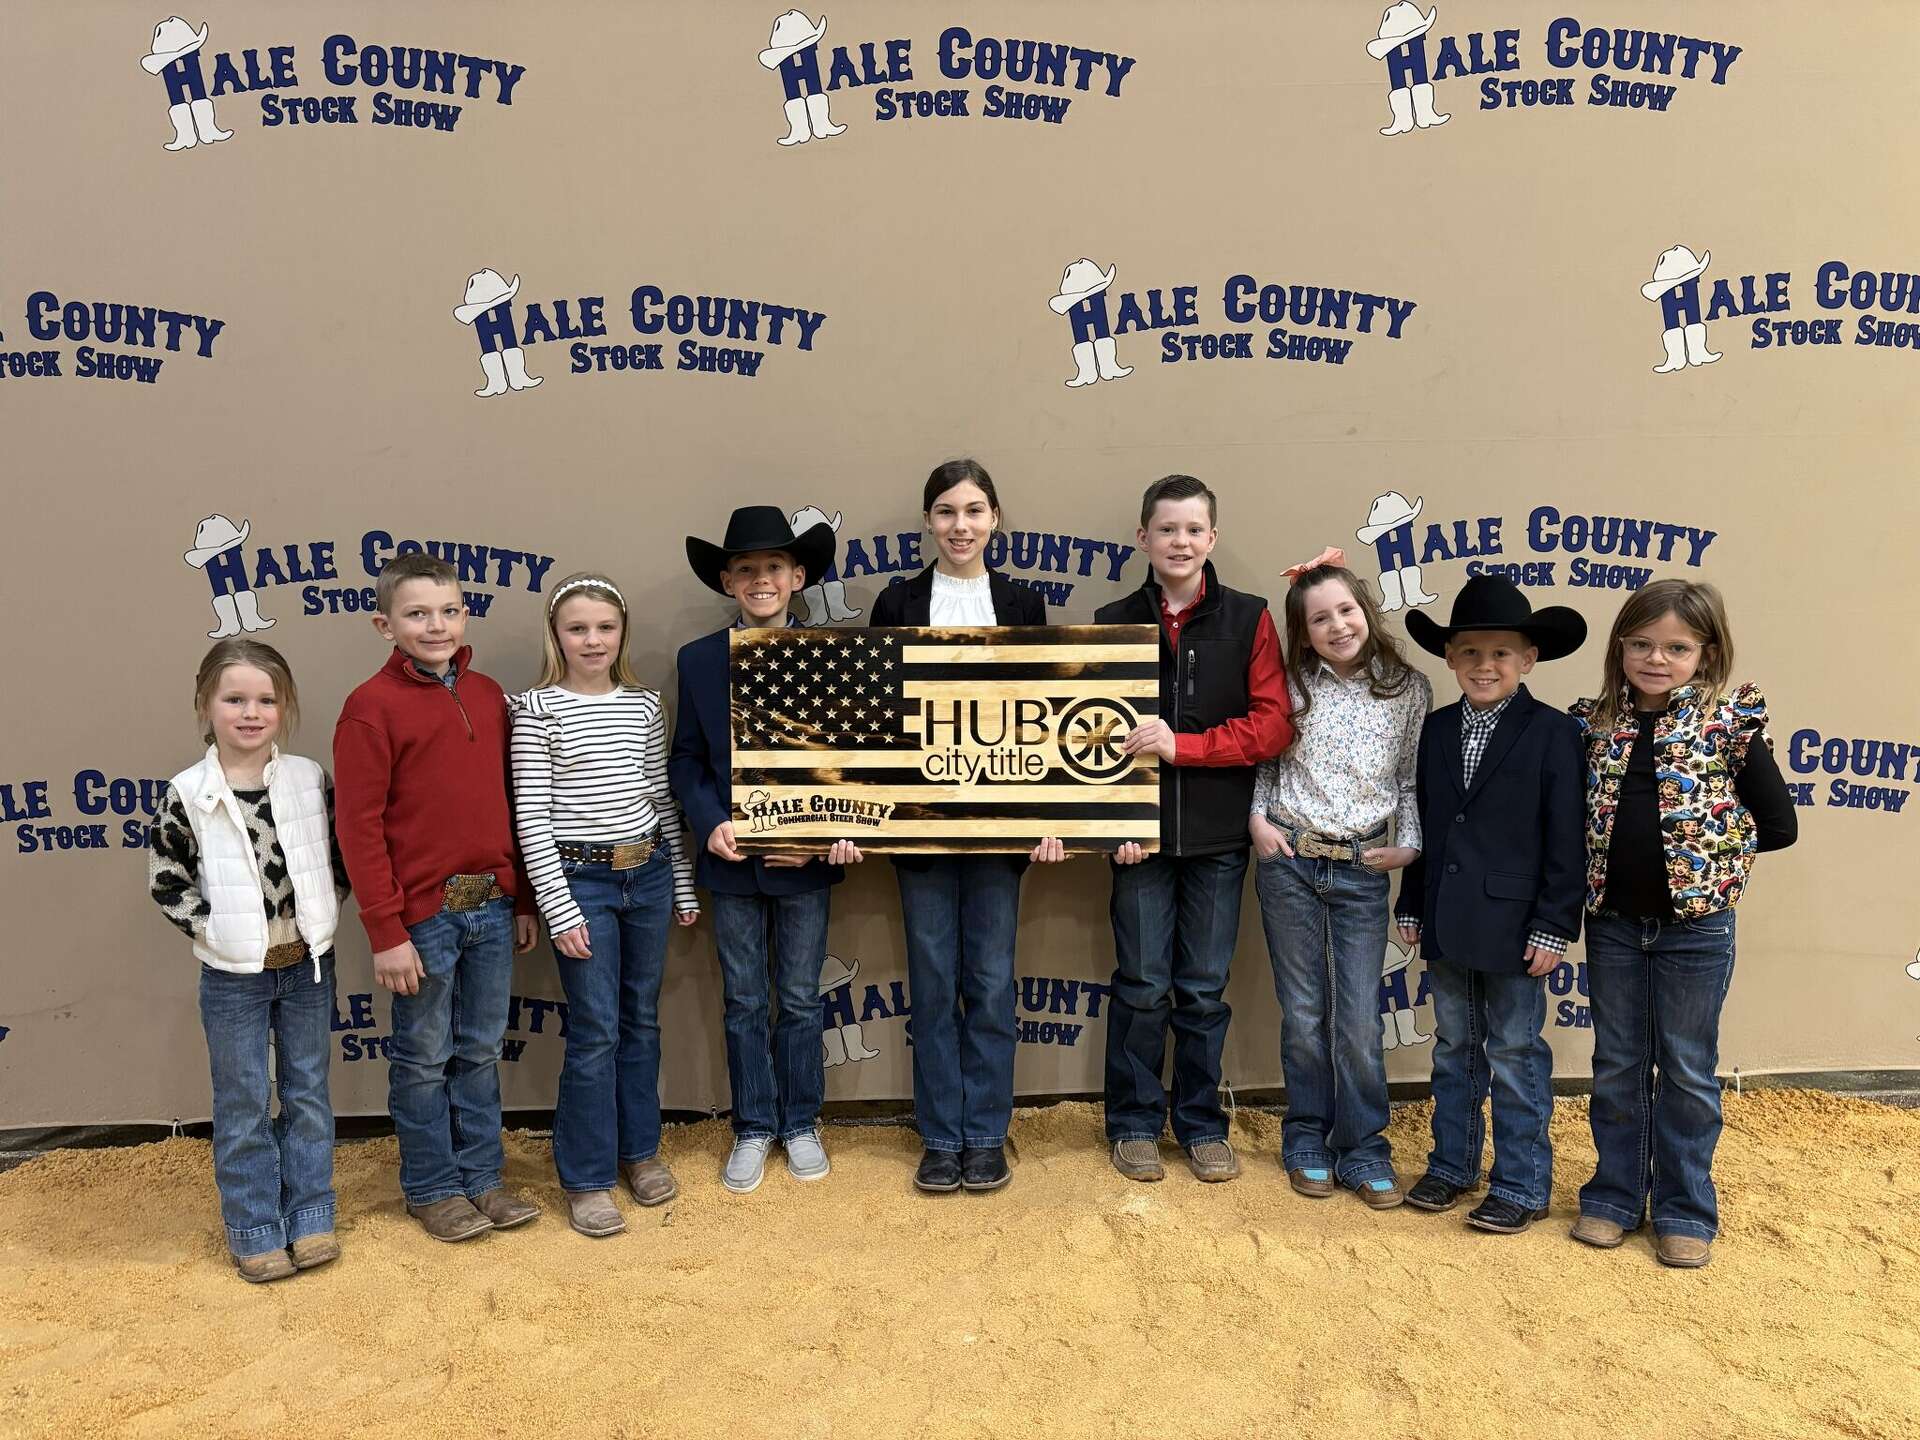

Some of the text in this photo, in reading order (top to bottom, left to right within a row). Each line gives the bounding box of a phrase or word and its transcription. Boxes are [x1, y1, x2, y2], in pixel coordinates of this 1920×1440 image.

[937, 26, 1137, 98] COUNTY
[1544, 17, 1744, 85] COUNTY
[320, 34, 527, 106] COUNTY
[875, 86, 1072, 124] STOCK SHOW
[1480, 74, 1677, 111] STOCK SHOW
[261, 92, 463, 132] STOCK SHOW
[25, 291, 226, 358] COUNTY
[630, 286, 827, 351] COUNTY
[1223, 274, 1417, 340] COUNTY
[1161, 329, 1353, 364] STOCK SHOW
[1751, 318, 1844, 349] STOCK
[76, 346, 164, 383] SHOW
[571, 340, 764, 376] STOCK SHOW
[1526, 506, 1718, 567] COUNTY
[824, 531, 1136, 583] ALE OUNTY
[1568, 557, 1654, 591] SHOW
[303, 585, 377, 616] STOC
[926, 700, 1050, 746] HUB
[925, 747, 1044, 782] city title
[809, 794, 891, 818] COUNTY
[1827, 778, 1910, 813] SHOW
[777, 812, 881, 827] COMMERCIAL STEER SHOW
[16, 823, 109, 854] STOCK
[823, 981, 911, 1030] HAL
